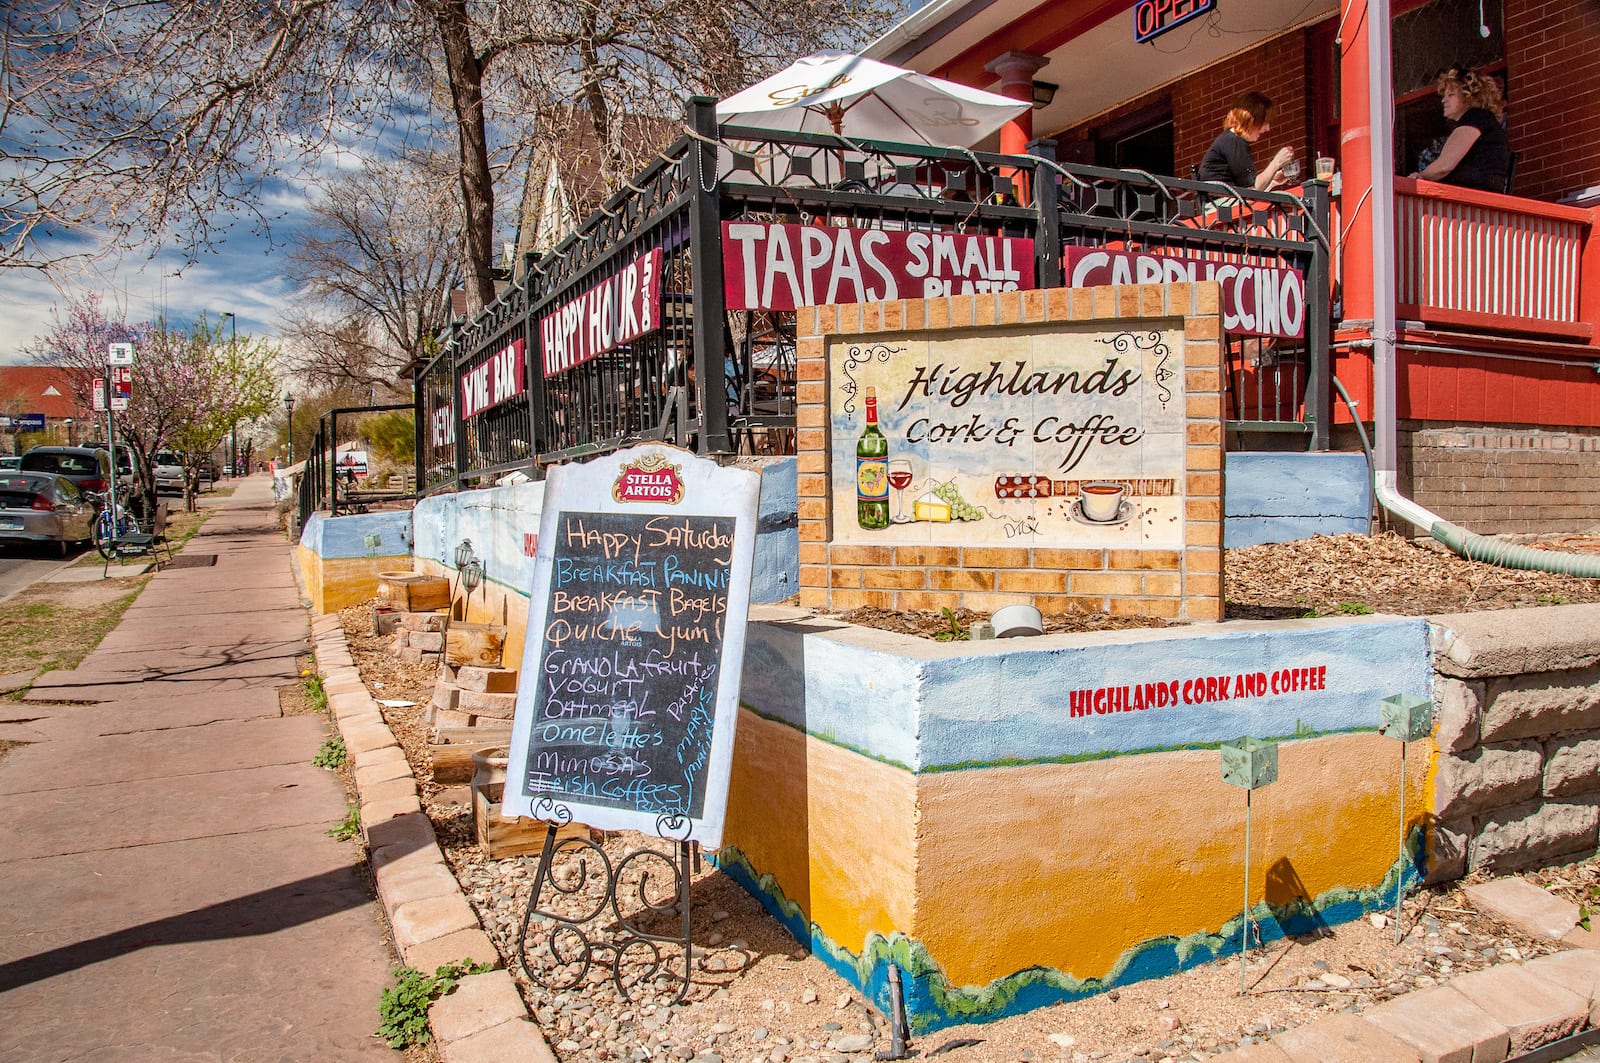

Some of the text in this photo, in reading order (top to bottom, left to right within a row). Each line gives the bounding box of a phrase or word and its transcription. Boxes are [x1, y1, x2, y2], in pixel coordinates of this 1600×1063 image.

[729, 223, 1020, 309] TAPAS SMALL
[543, 263, 638, 374] HAPPY HOUR
[494, 345, 516, 404] BAR
[897, 358, 1141, 412] Highlands
[906, 414, 1145, 474] Cork & Coffee
[624, 485, 672, 497] ARTOIS
[626, 474, 673, 485] STELLA
[1069, 665, 1327, 718] HIGHLANDS CORK AND COFFEE
